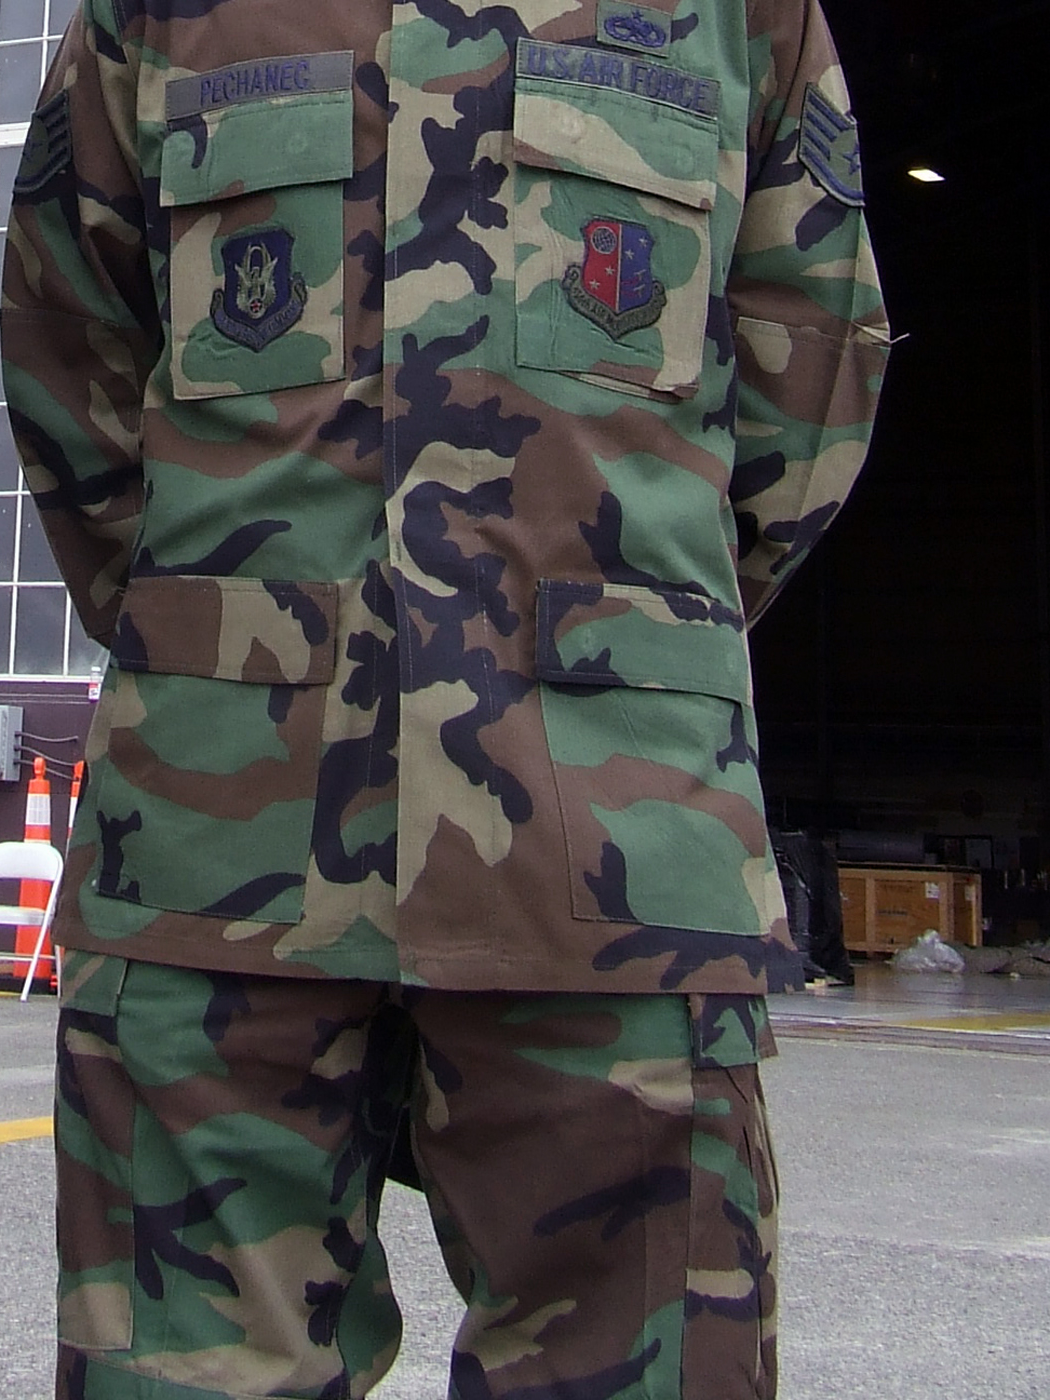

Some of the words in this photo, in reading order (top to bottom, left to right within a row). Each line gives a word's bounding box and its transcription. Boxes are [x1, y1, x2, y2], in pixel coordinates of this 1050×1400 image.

[200, 59, 311, 106] PECHANEC
[578, 52, 624, 90] AIR
[630, 62, 711, 112] FORCE
